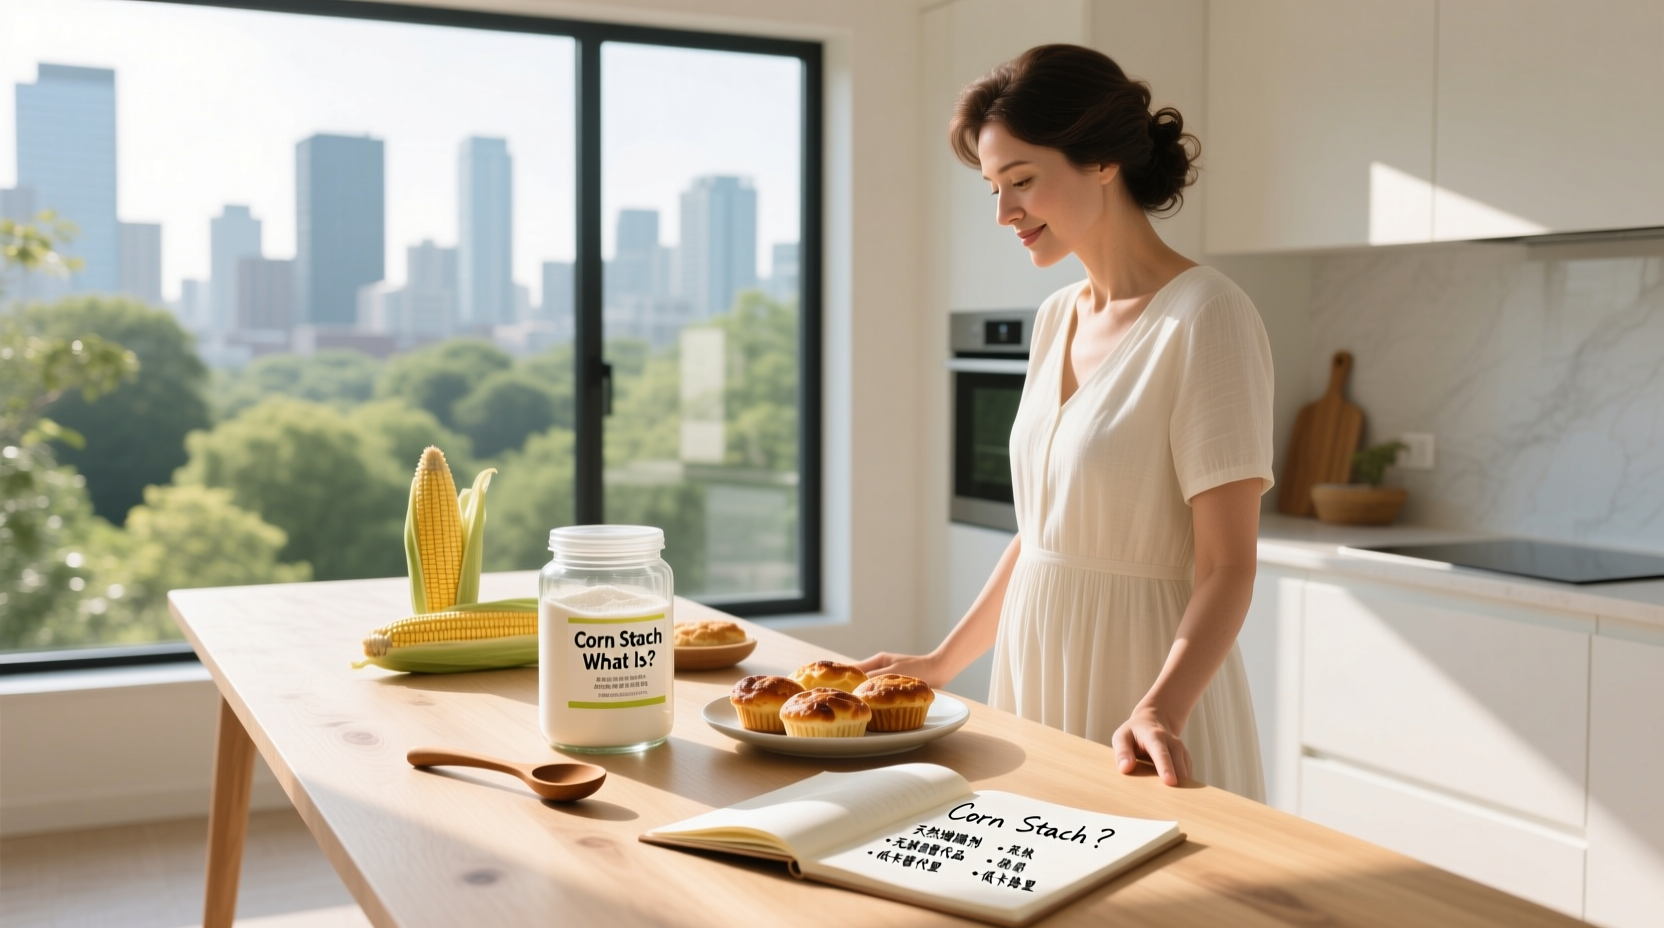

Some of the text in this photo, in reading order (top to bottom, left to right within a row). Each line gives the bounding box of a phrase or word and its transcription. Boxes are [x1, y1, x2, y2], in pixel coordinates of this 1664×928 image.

[574, 626, 663, 649] Corn Stach
[582, 649, 656, 671] What Is?
[948, 802, 1005, 829] Corn
